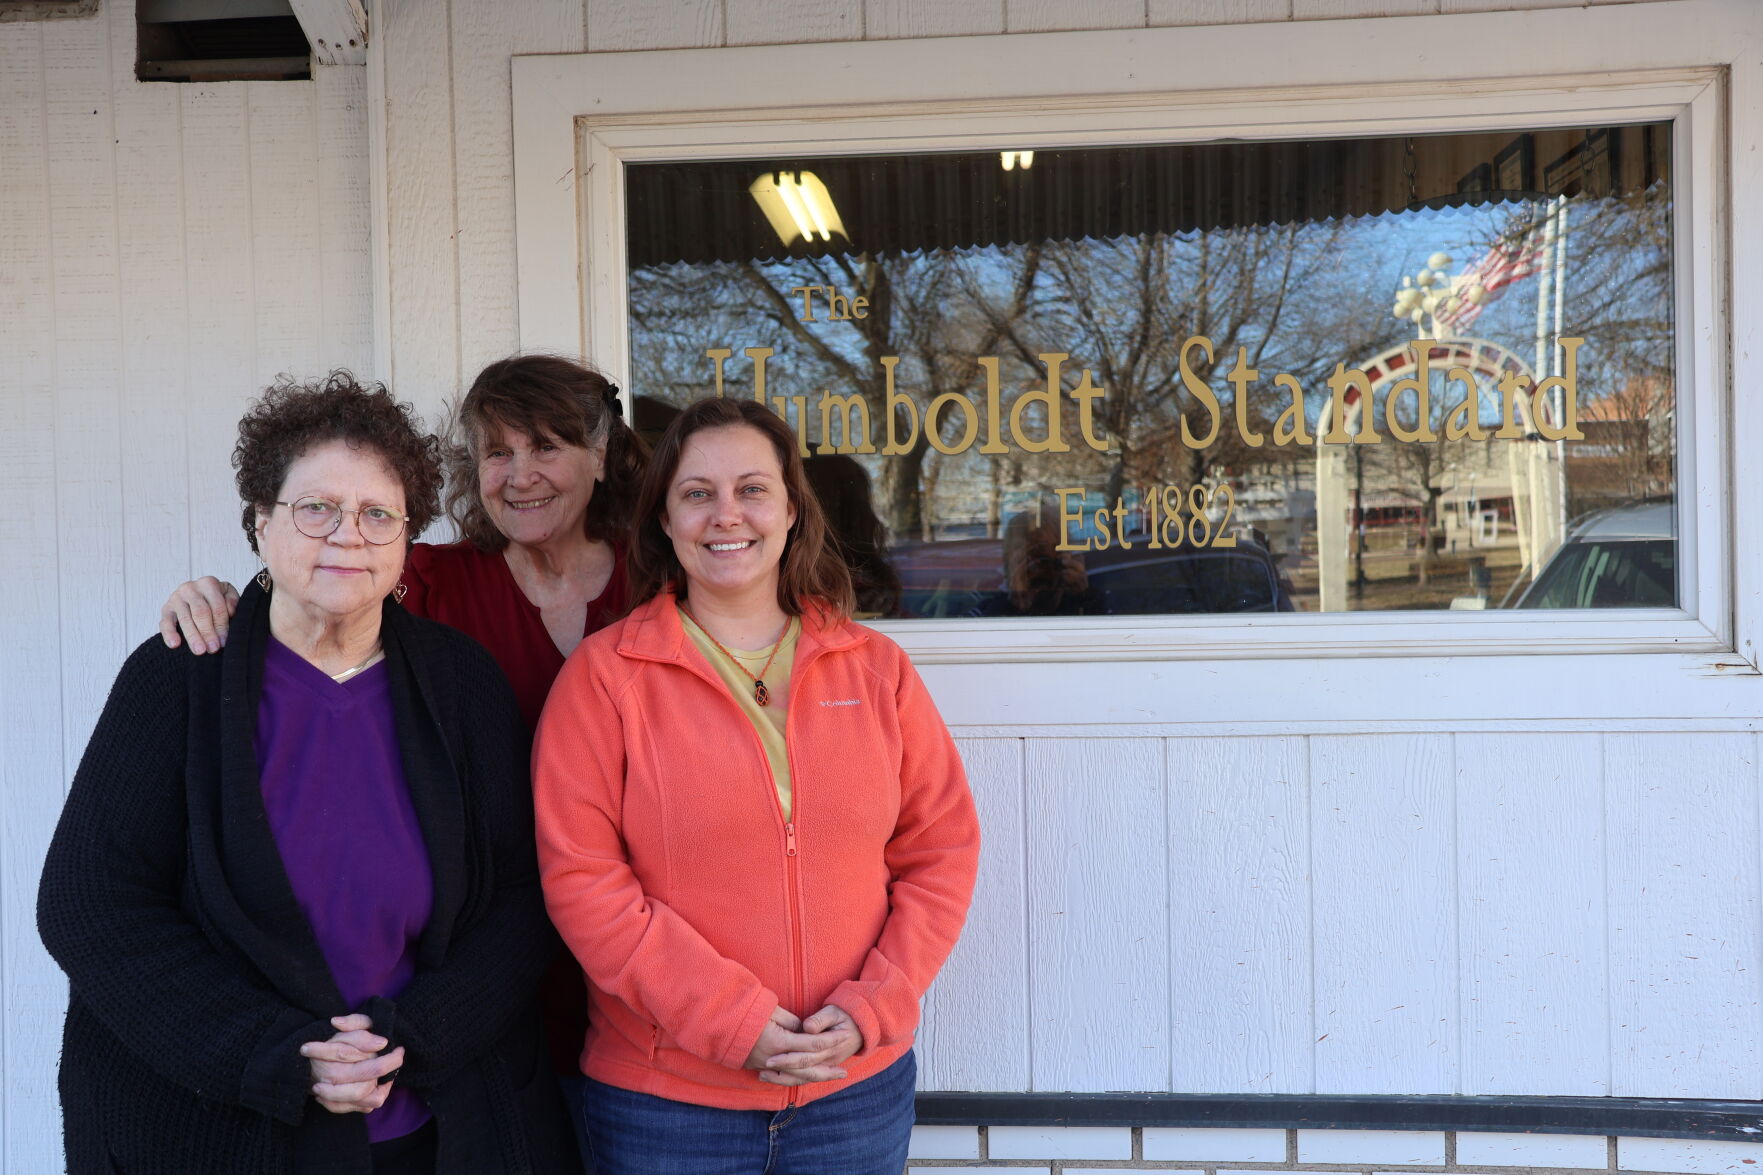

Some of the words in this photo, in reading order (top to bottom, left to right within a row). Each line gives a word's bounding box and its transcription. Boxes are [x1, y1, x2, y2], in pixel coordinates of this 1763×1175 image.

[792, 285, 870, 323] The
[1179, 335, 1586, 450] Standard
[1054, 487, 1132, 551] Est
[1144, 484, 1237, 549] 1882
